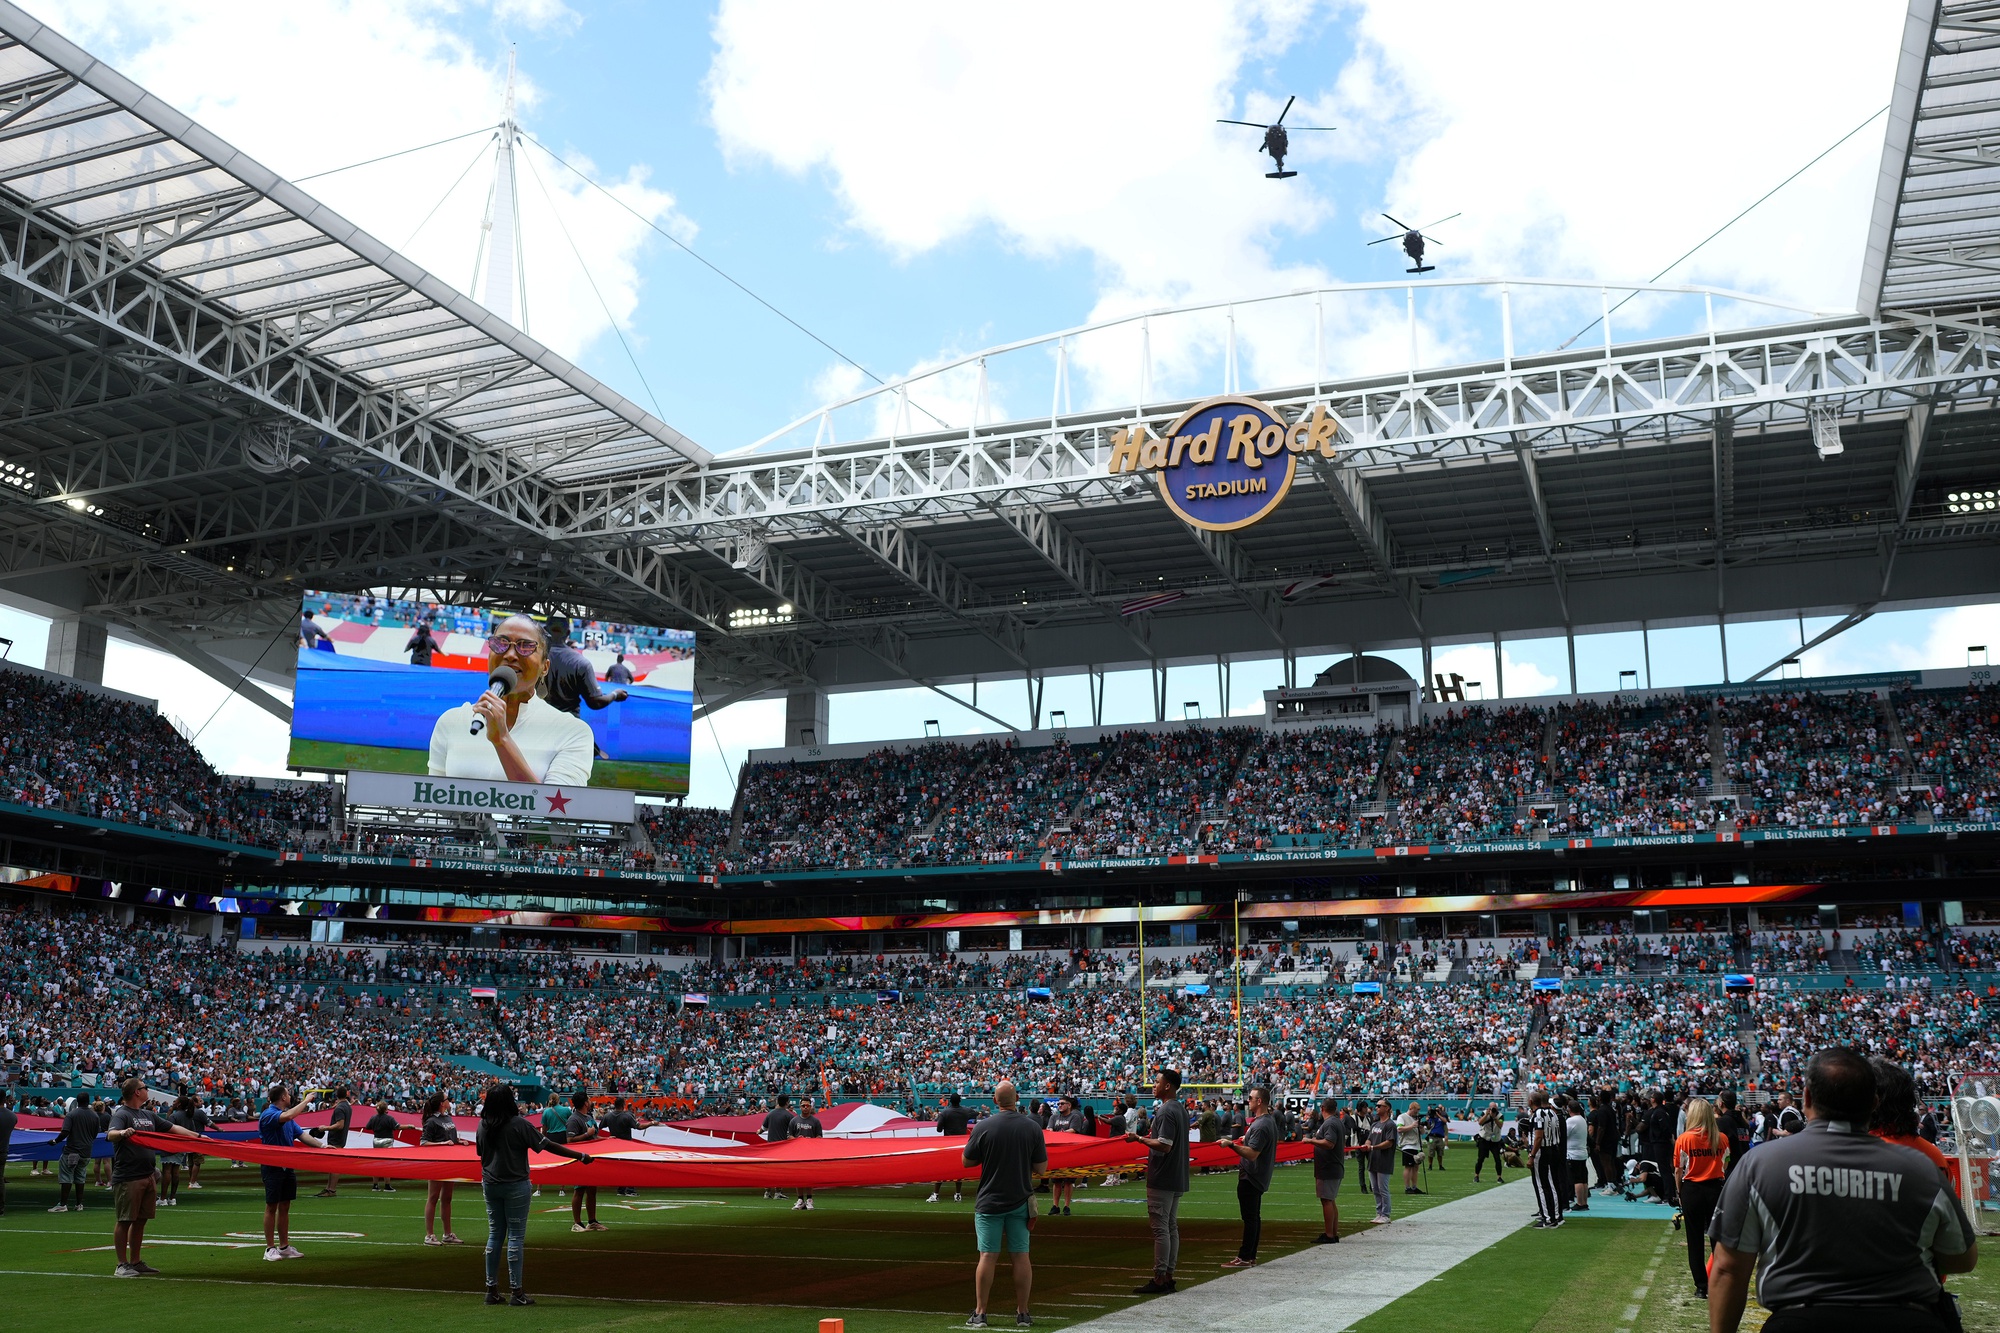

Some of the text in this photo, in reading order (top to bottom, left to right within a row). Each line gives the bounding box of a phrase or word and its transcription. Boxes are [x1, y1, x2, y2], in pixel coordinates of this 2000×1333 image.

[1109, 405, 1338, 474] Hard Rock
[1185, 477, 1267, 500] STADIUM
[1971, 670, 1991, 680] 308
[1622, 695, 1639, 703] 306
[1052, 732, 1066, 740] 302
[807, 748, 821, 757] 356
[274, 779, 293, 788] 352
[413, 782, 536, 811] Heineken
[1764, 828, 1846, 840] BILL STANFILL 84
[1928, 824, 1953, 833] JAKE
[1955, 823, 1987, 832] SCOTT
[1454, 841, 1541, 853] ZACH THOMAS 54
[1612, 835, 1694, 847] JIM MANDICH 88
[322, 854, 392, 866] SUPER BOWL VII
[1253, 850, 1337, 861] JASON TAYLOR 99
[440, 860, 577, 876] 1972 PERFECT SEASON TEAM 17-0
[1068, 857, 1160, 869] MANNY FERNANDEZ 75
[620, 871, 685, 882] SUPER BOWL VIII
[1689, 1148, 1723, 1157] SECURTY
[1788, 1165, 1903, 1202] SECURITY
